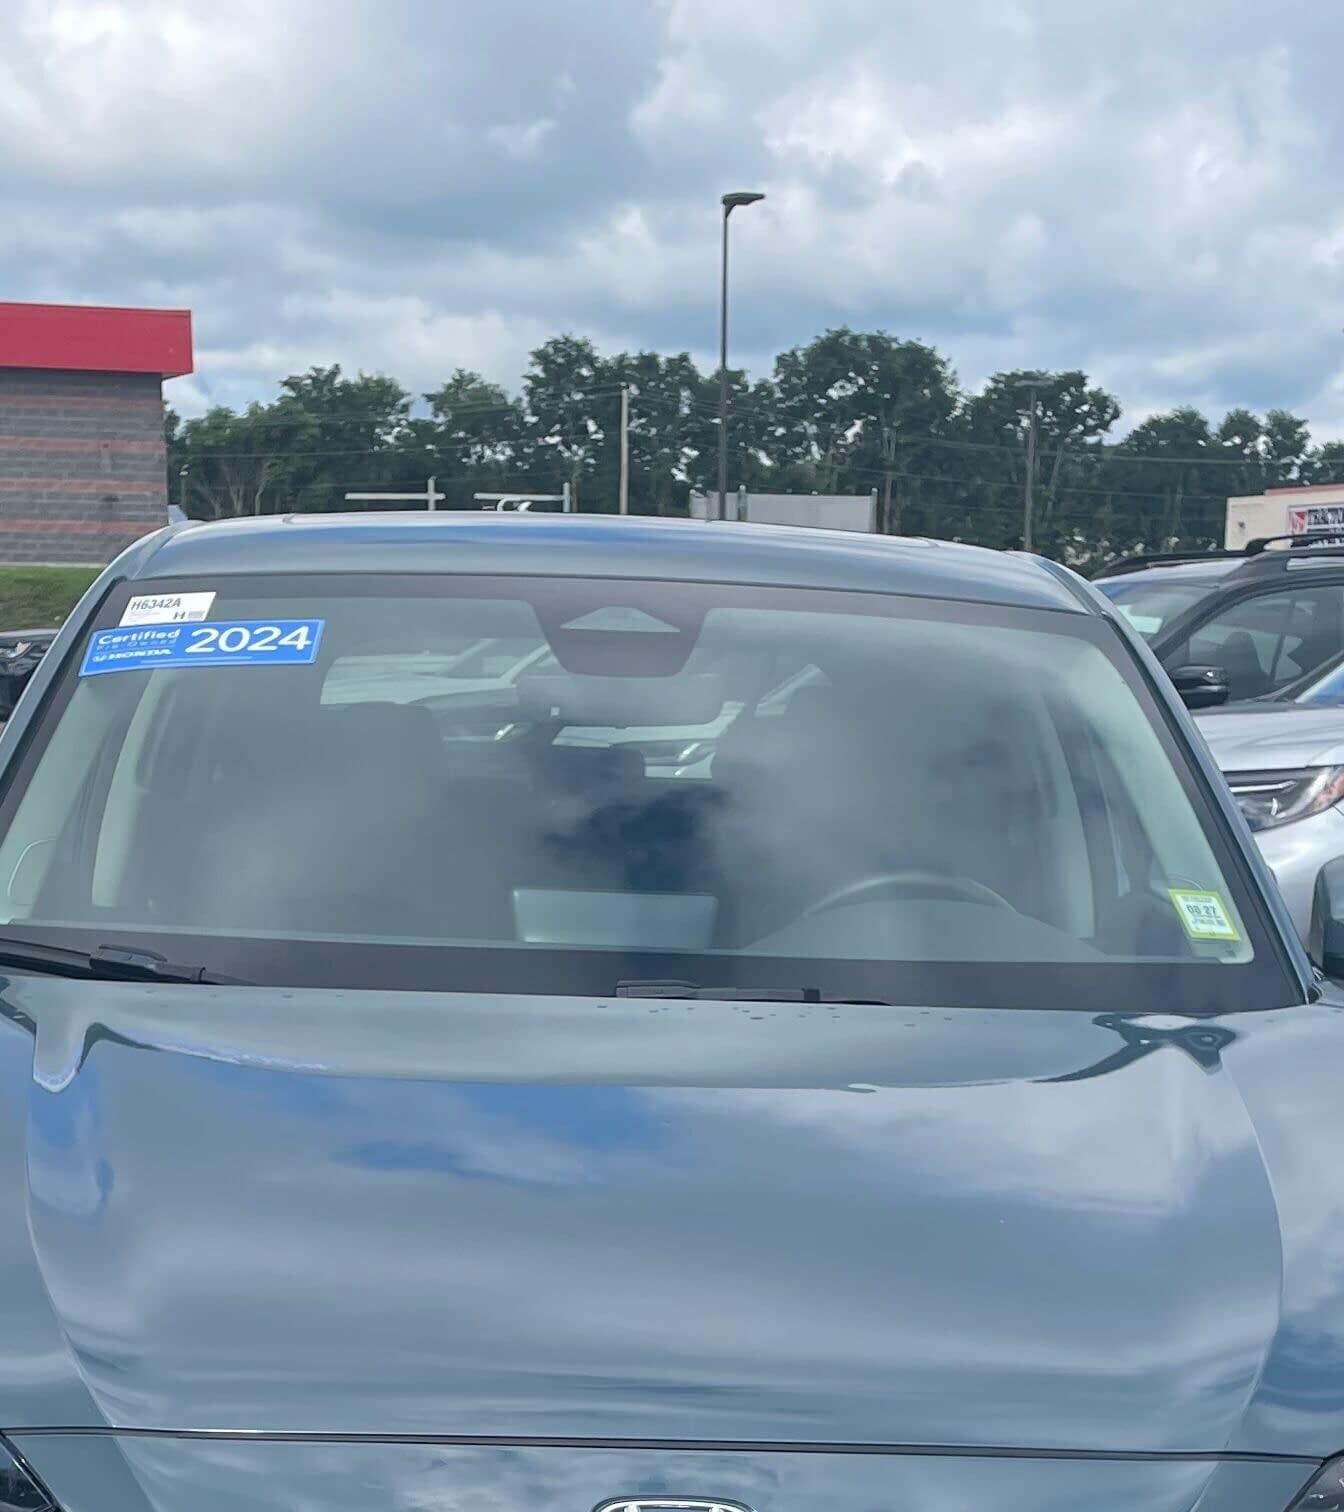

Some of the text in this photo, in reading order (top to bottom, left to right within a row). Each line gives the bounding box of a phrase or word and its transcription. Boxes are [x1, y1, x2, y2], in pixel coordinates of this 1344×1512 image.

[131, 598, 181, 610] H6342A
[98, 629, 181, 645] Certified
[184, 626, 312, 653] 2024
[108, 648, 172, 660] HONDA
